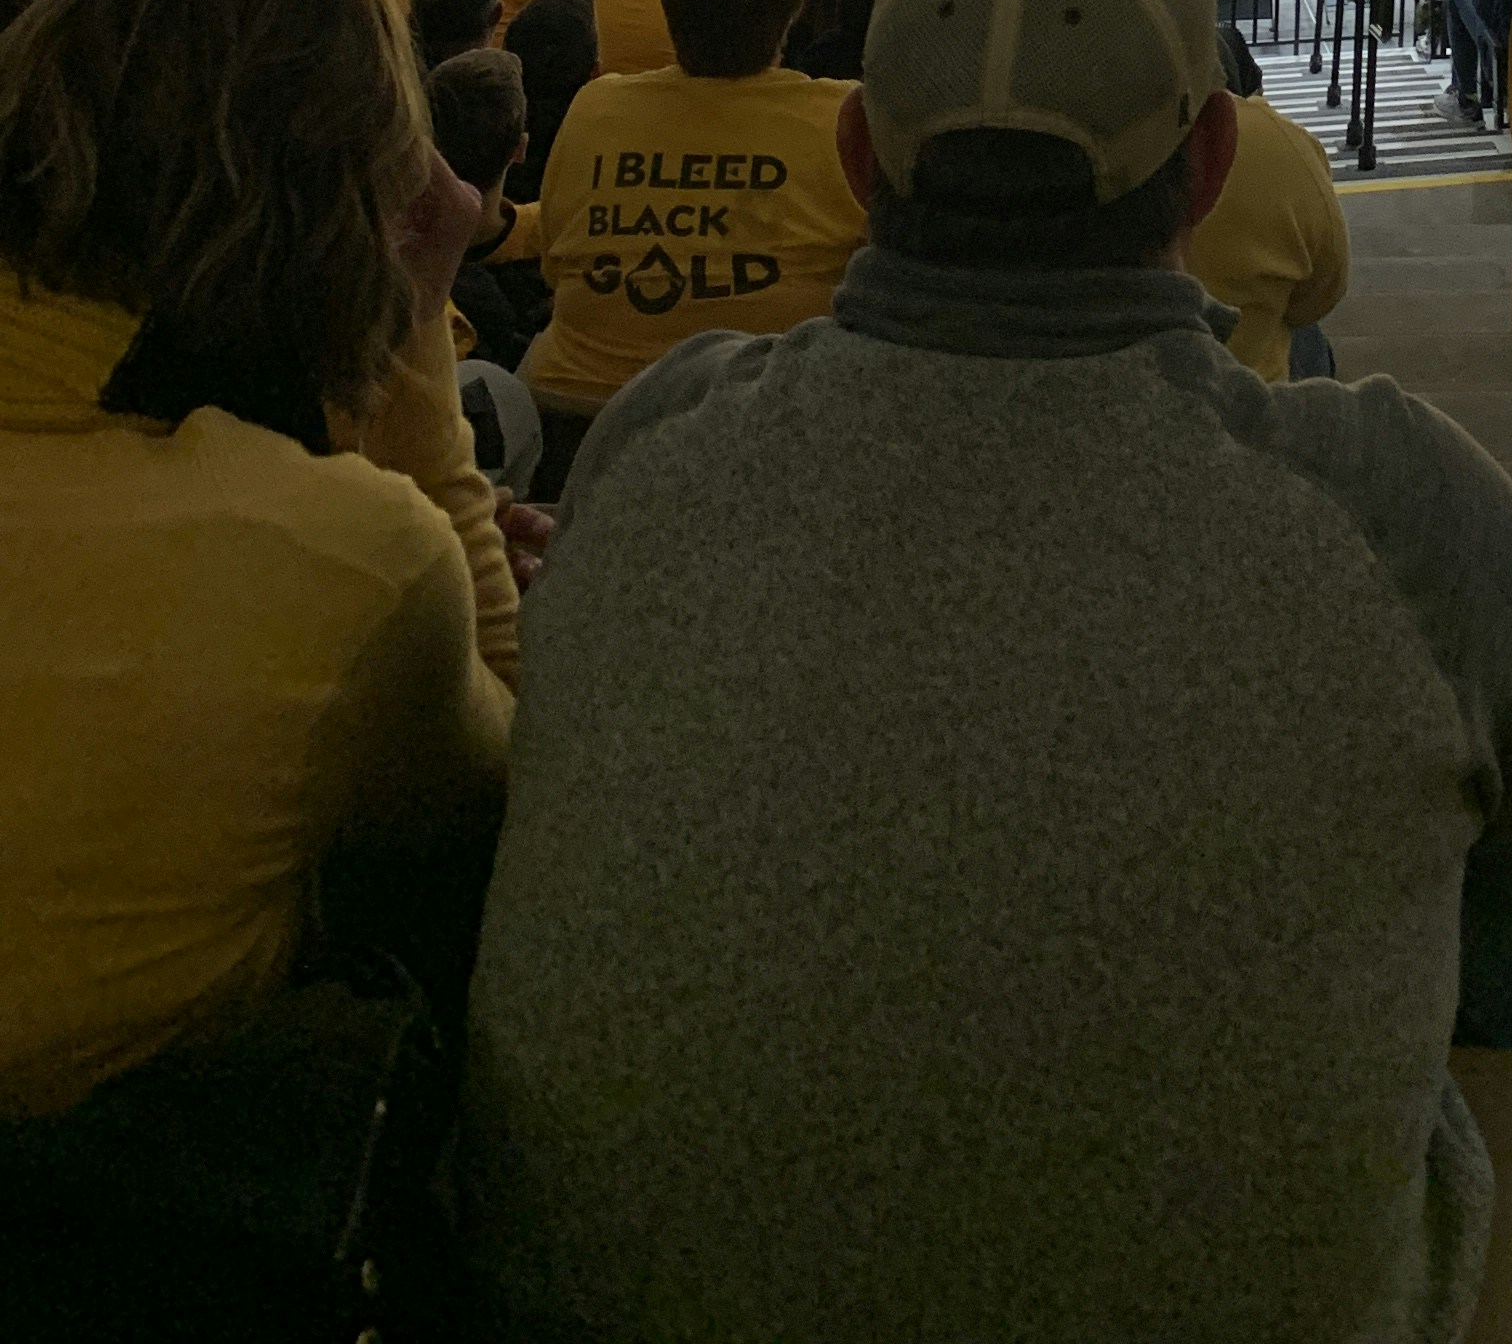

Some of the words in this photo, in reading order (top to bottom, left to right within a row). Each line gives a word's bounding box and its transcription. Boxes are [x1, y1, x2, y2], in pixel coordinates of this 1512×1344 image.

[592, 154, 603, 191] I
[614, 151, 788, 191] BLEED
[587, 204, 731, 238] BLACK
[583, 242, 781, 316] GOLD
